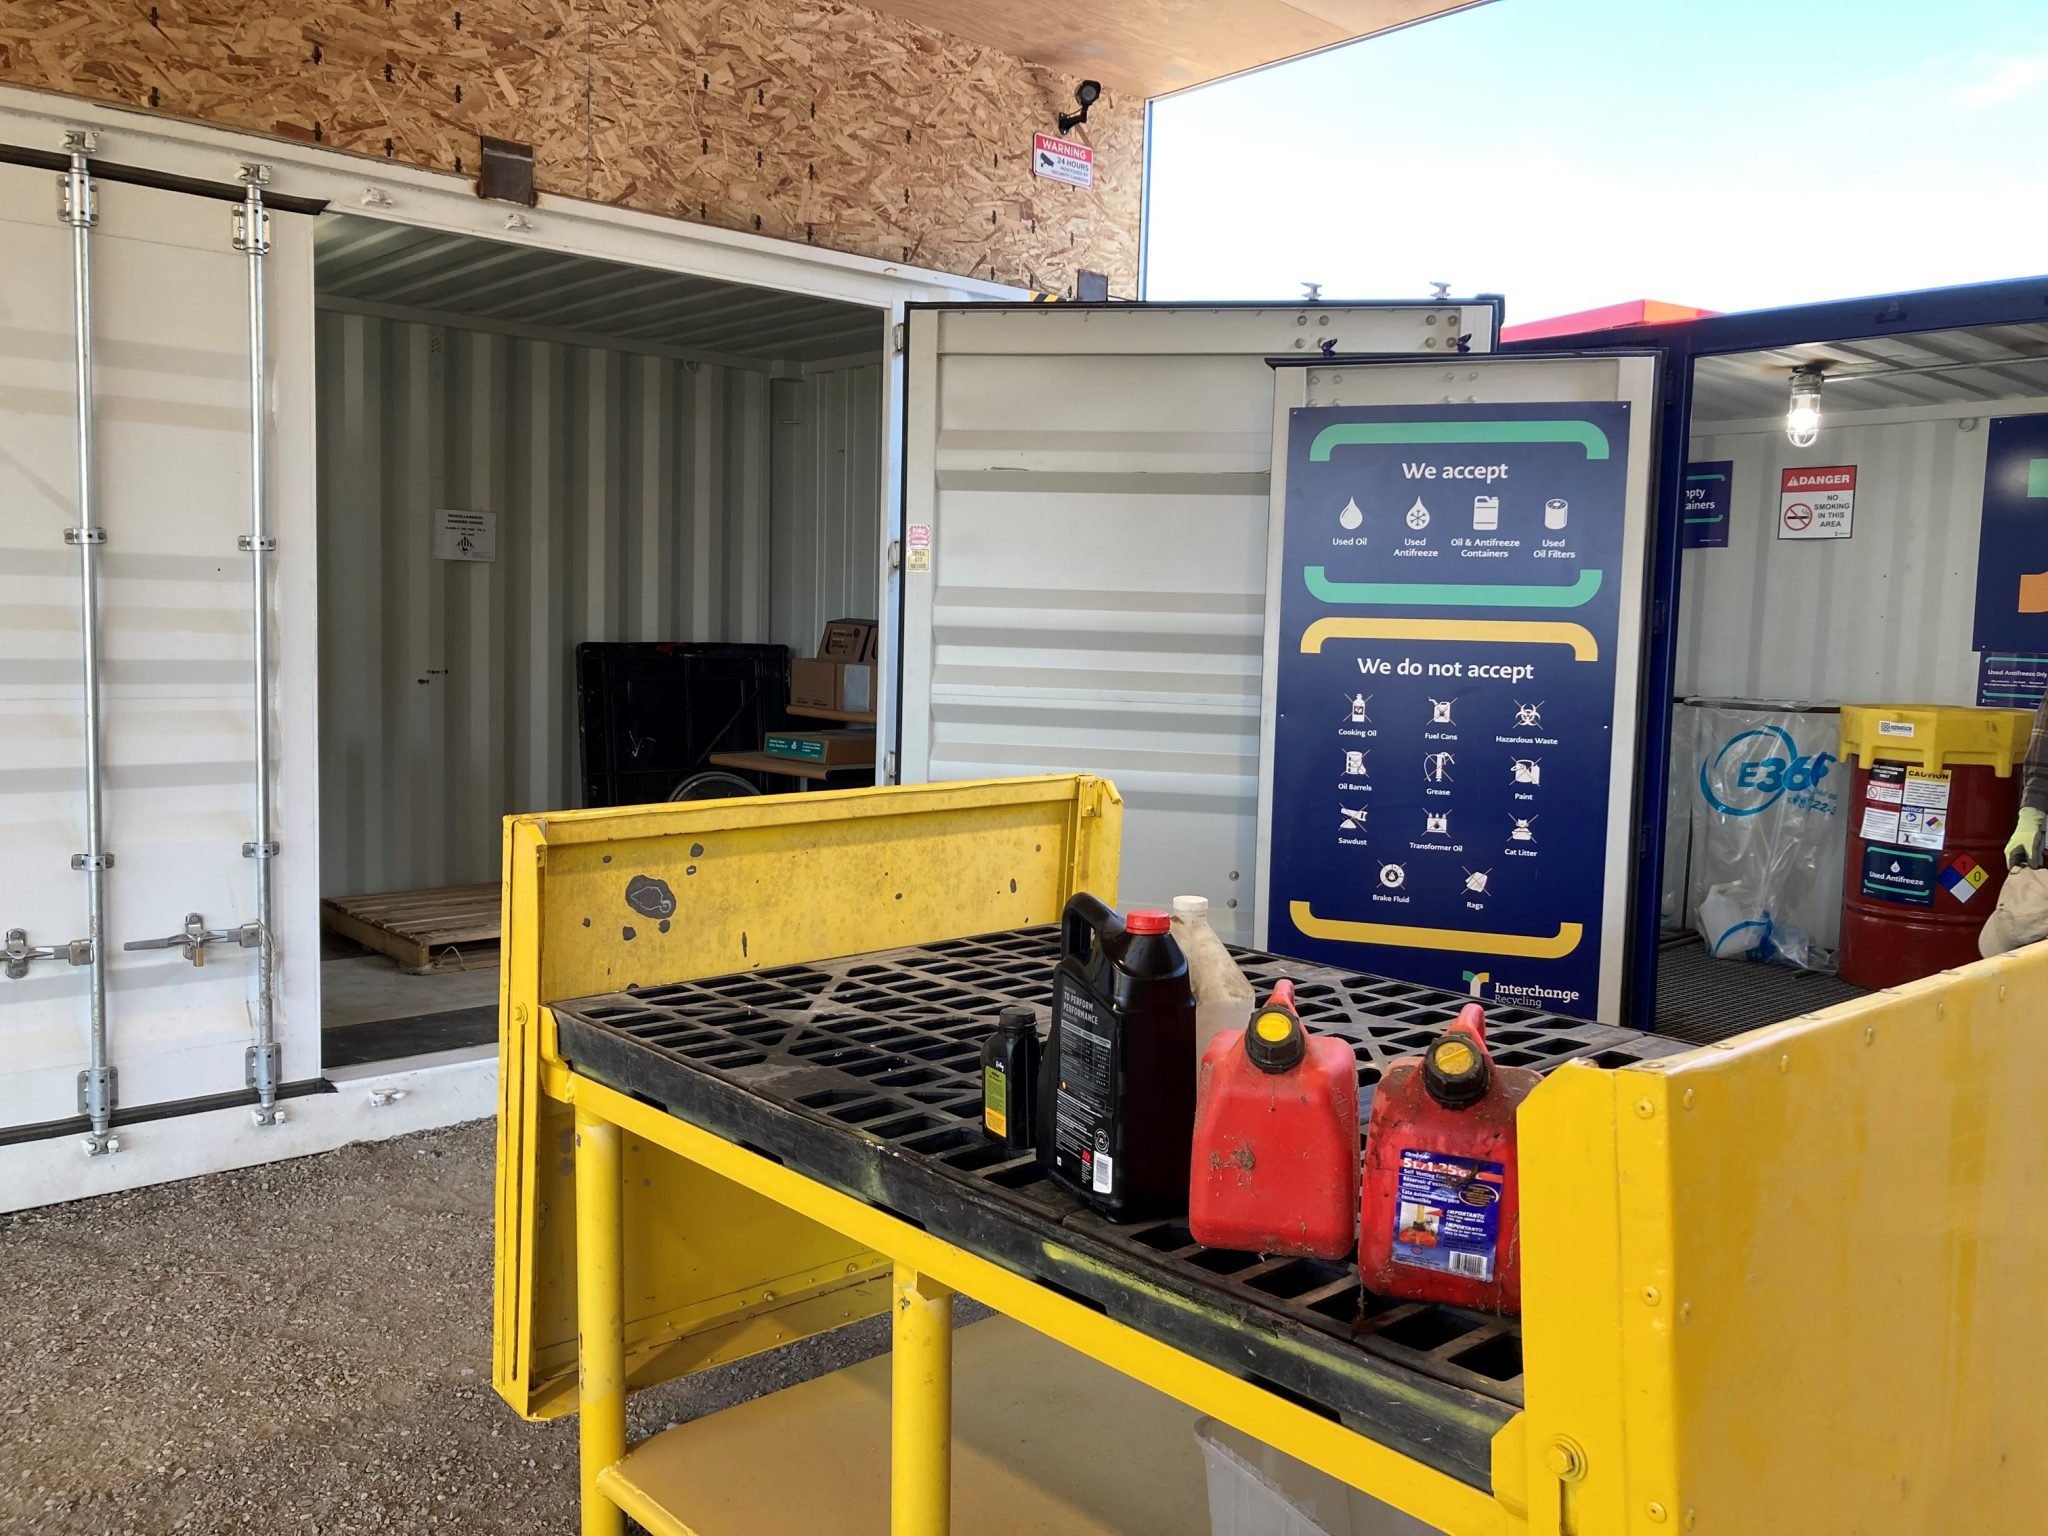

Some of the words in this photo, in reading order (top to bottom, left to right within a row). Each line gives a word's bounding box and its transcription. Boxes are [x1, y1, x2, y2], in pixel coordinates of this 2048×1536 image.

[1042, 138, 1086, 160] WARNING
[1057, 156, 1065, 165] 24
[1067, 159, 1089, 172] HOURS
[1402, 462, 1437, 479] We
[1442, 464, 1509, 484] accept
[1799, 474, 1850, 486] DANGER
[1814, 502, 1850, 510] SMOKING
[1332, 538, 1354, 546] Used
[1355, 538, 1368, 546] Oil
[1404, 538, 1426, 546] Used
[1450, 538, 1463, 547] Oil
[1465, 539, 1472, 547] &
[1474, 538, 1520, 547] Antifreeze
[1542, 539, 1566, 548] Used
[1393, 548, 1439, 557] Antifreeze
[1461, 549, 1509, 558] Containers
[1533, 550, 1546, 558] Oil
[1548, 550, 1576, 559] Filters
[1357, 657, 1392, 674] We
[1396, 658, 1423, 676] do
[1428, 662, 1463, 678] not
[1467, 664, 1535, 684] accept
[1338, 728, 1366, 738] Cooking
[1424, 732, 1439, 740] Fuel
[1440, 733, 1458, 741] Cans
[1496, 736, 1534, 744] Hazardous
[1338, 783, 1348, 791] Oil
[1349, 784, 1372, 792] Barrels
[1426, 788, 1450, 796] Grease
[1514, 793, 1533, 801] Paint
[1338, 837, 1367, 846] Sawdust
[1409, 842, 1452, 851] Transformer
[1453, 844, 1463, 852] Oil
[1504, 848, 1517, 856] Cat
[1518, 849, 1538, 857] Litter
[1961, 861, 1967, 871] 1
[1869, 871, 1884, 880] Used
[1886, 874, 1924, 886] Antifreeze
[1974, 871, 1981, 882] 0
[1372, 894, 1392, 902] Brake
[1393, 895, 1410, 904] Fluid
[1467, 901, 1484, 911] Rags
[1495, 982, 1580, 1003] Interchange
[1064, 991, 1070, 1001] TO
[1070, 994, 1093, 1012] PERFORM
[1494, 994, 1542, 1009] Recycling
[1063, 1002, 1099, 1025] PERFORMANCE
[1416, 1170, 1435, 1179] Venting
